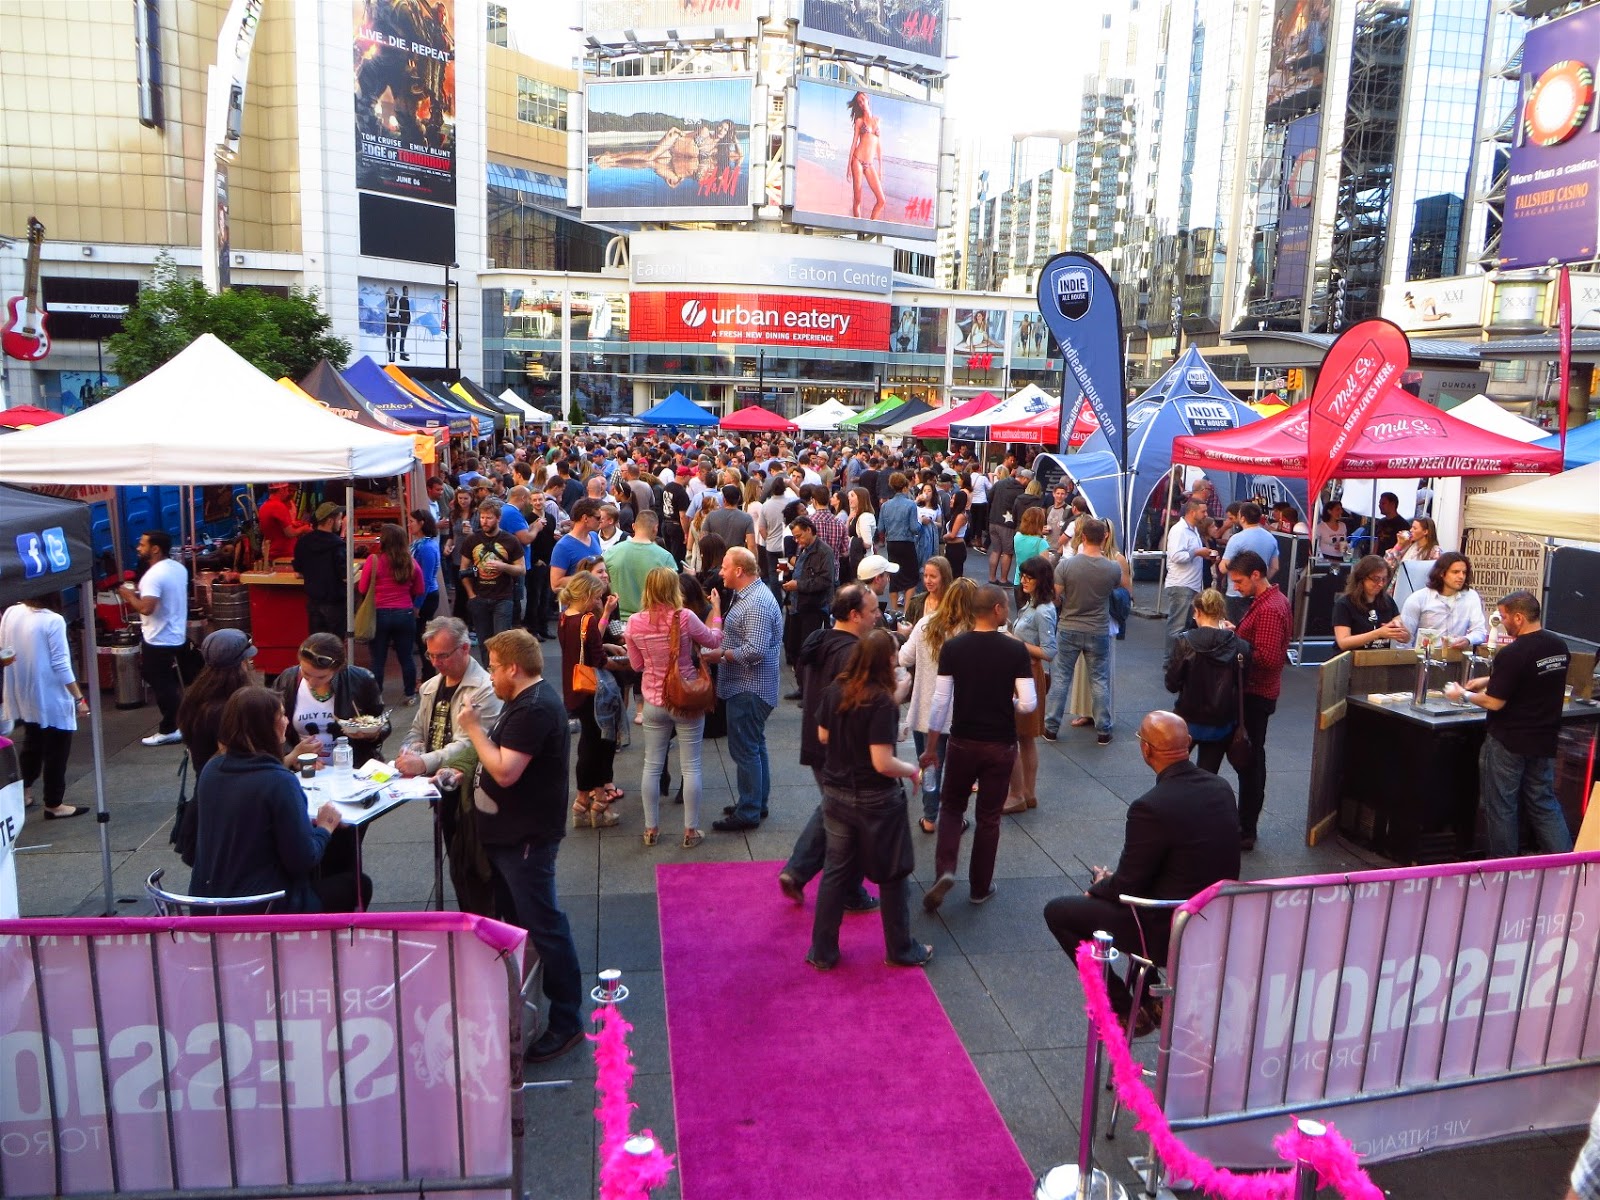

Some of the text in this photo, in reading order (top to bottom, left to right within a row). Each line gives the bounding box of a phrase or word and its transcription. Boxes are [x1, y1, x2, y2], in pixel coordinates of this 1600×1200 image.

[359, 27, 387, 45] LIVE.
[388, 36, 409, 51] DIE.
[361, 133, 451, 158] TOM CRUISE EMILY BLUNT
[361, 142, 387, 159] EDGE
[387, 150, 397, 161] OF
[1510, 158, 1599, 186] More than a casino.
[396, 175, 421, 186] JUNE 06
[697, 165, 740, 199] H&M
[1514, 182, 1589, 210] FALLSVIEW CASINO
[904, 196, 933, 221] H&M
[1514, 200, 1586, 219] NIAGARA FALLS
[788, 263, 837, 283] Eaton
[843, 268, 888, 287] Centre
[1059, 278, 1086, 292] INDIE
[1071, 293, 1086, 301] HOUSE
[1582, 287, 1600, 300] XX
[711, 304, 851, 335] urban eatery
[711, 330, 717, 338] A
[765, 332, 790, 340] DINING
[793, 333, 834, 342] EXPERIENCE
[1188, 372, 1206, 381] INDIE
[1060, 337, 1116, 437] indiealehouse.com
[1441, 381, 1477, 389] DUNDAS
[1327, 373, 1357, 415] Mill
[375, 402, 413, 410] onkeys
[1188, 406, 1226, 417] INDIE
[1329, 361, 1396, 459] GREAT BEER LIVES HERE.
[1365, 420, 1409, 437] Mill
[1346, 459, 1365, 468] Mill
[1387, 458, 1416, 469] GREAT
[1421, 457, 1445, 469] BEER
[1447, 457, 1473, 470] LIVES
[1485, 540, 1507, 557] BEER
[1474, 558, 1539, 571] WHERE QUALITY
[1471, 570, 1509, 586] NTEGRITY
[1510, 576, 1538, 587] BYWORDS
[298, 712, 318, 721] JULY
